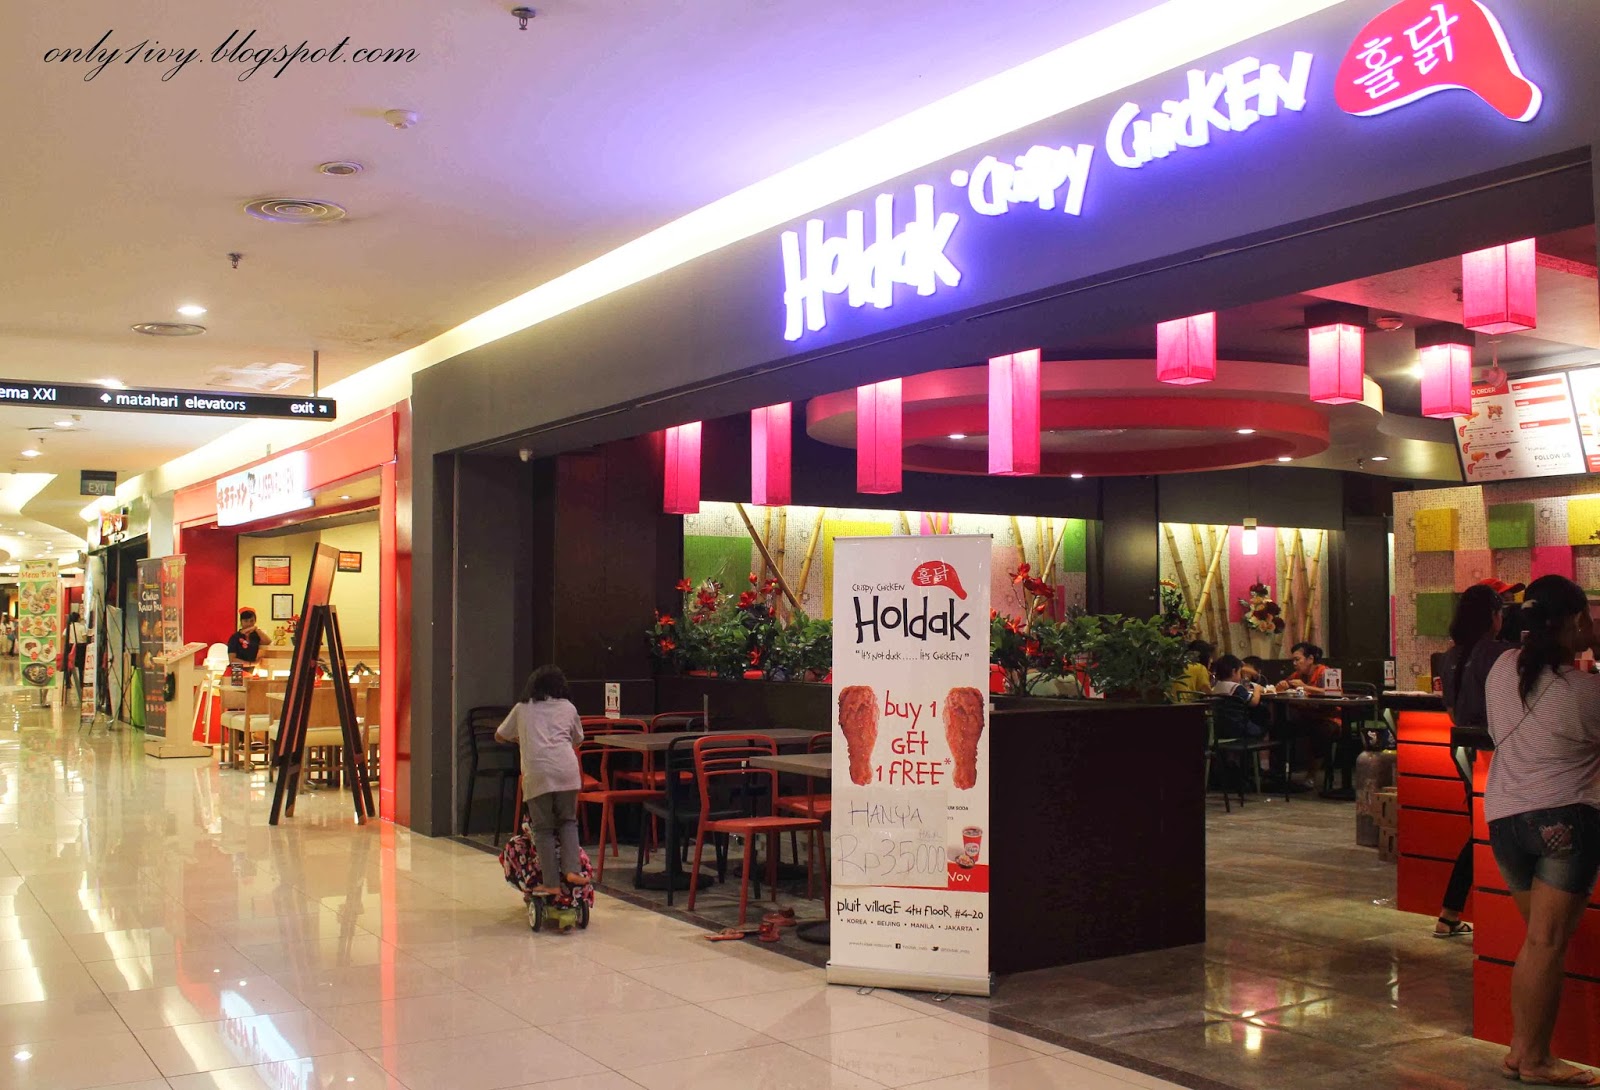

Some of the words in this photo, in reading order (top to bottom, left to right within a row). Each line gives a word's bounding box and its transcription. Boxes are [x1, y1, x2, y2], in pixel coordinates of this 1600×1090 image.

[1353, 3, 1459, 99] 홀닭
[781, 183, 961, 341] Holdak
[33, 388, 56, 401] XXI
[116, 390, 178, 408] matahari
[185, 393, 246, 411] elevators
[290, 401, 314, 414] exit
[1534, 453, 1561, 461] FOLLOW
[88, 482, 108, 493] EXIT
[853, 595, 971, 644] Holdak
[885, 690, 922, 729] buy
[930, 701, 937, 717] 1
[876, 765, 882, 781] 1
[848, 800, 923, 829] HANYA
[837, 898, 861, 916] pluit
[955, 909, 984, 919] #4-20
[846, 918, 868, 926] KOREA
[876, 920, 901, 928] BEIJING
[910, 922, 935, 930] MANILA
[944, 924, 973, 932] JAKARTA
